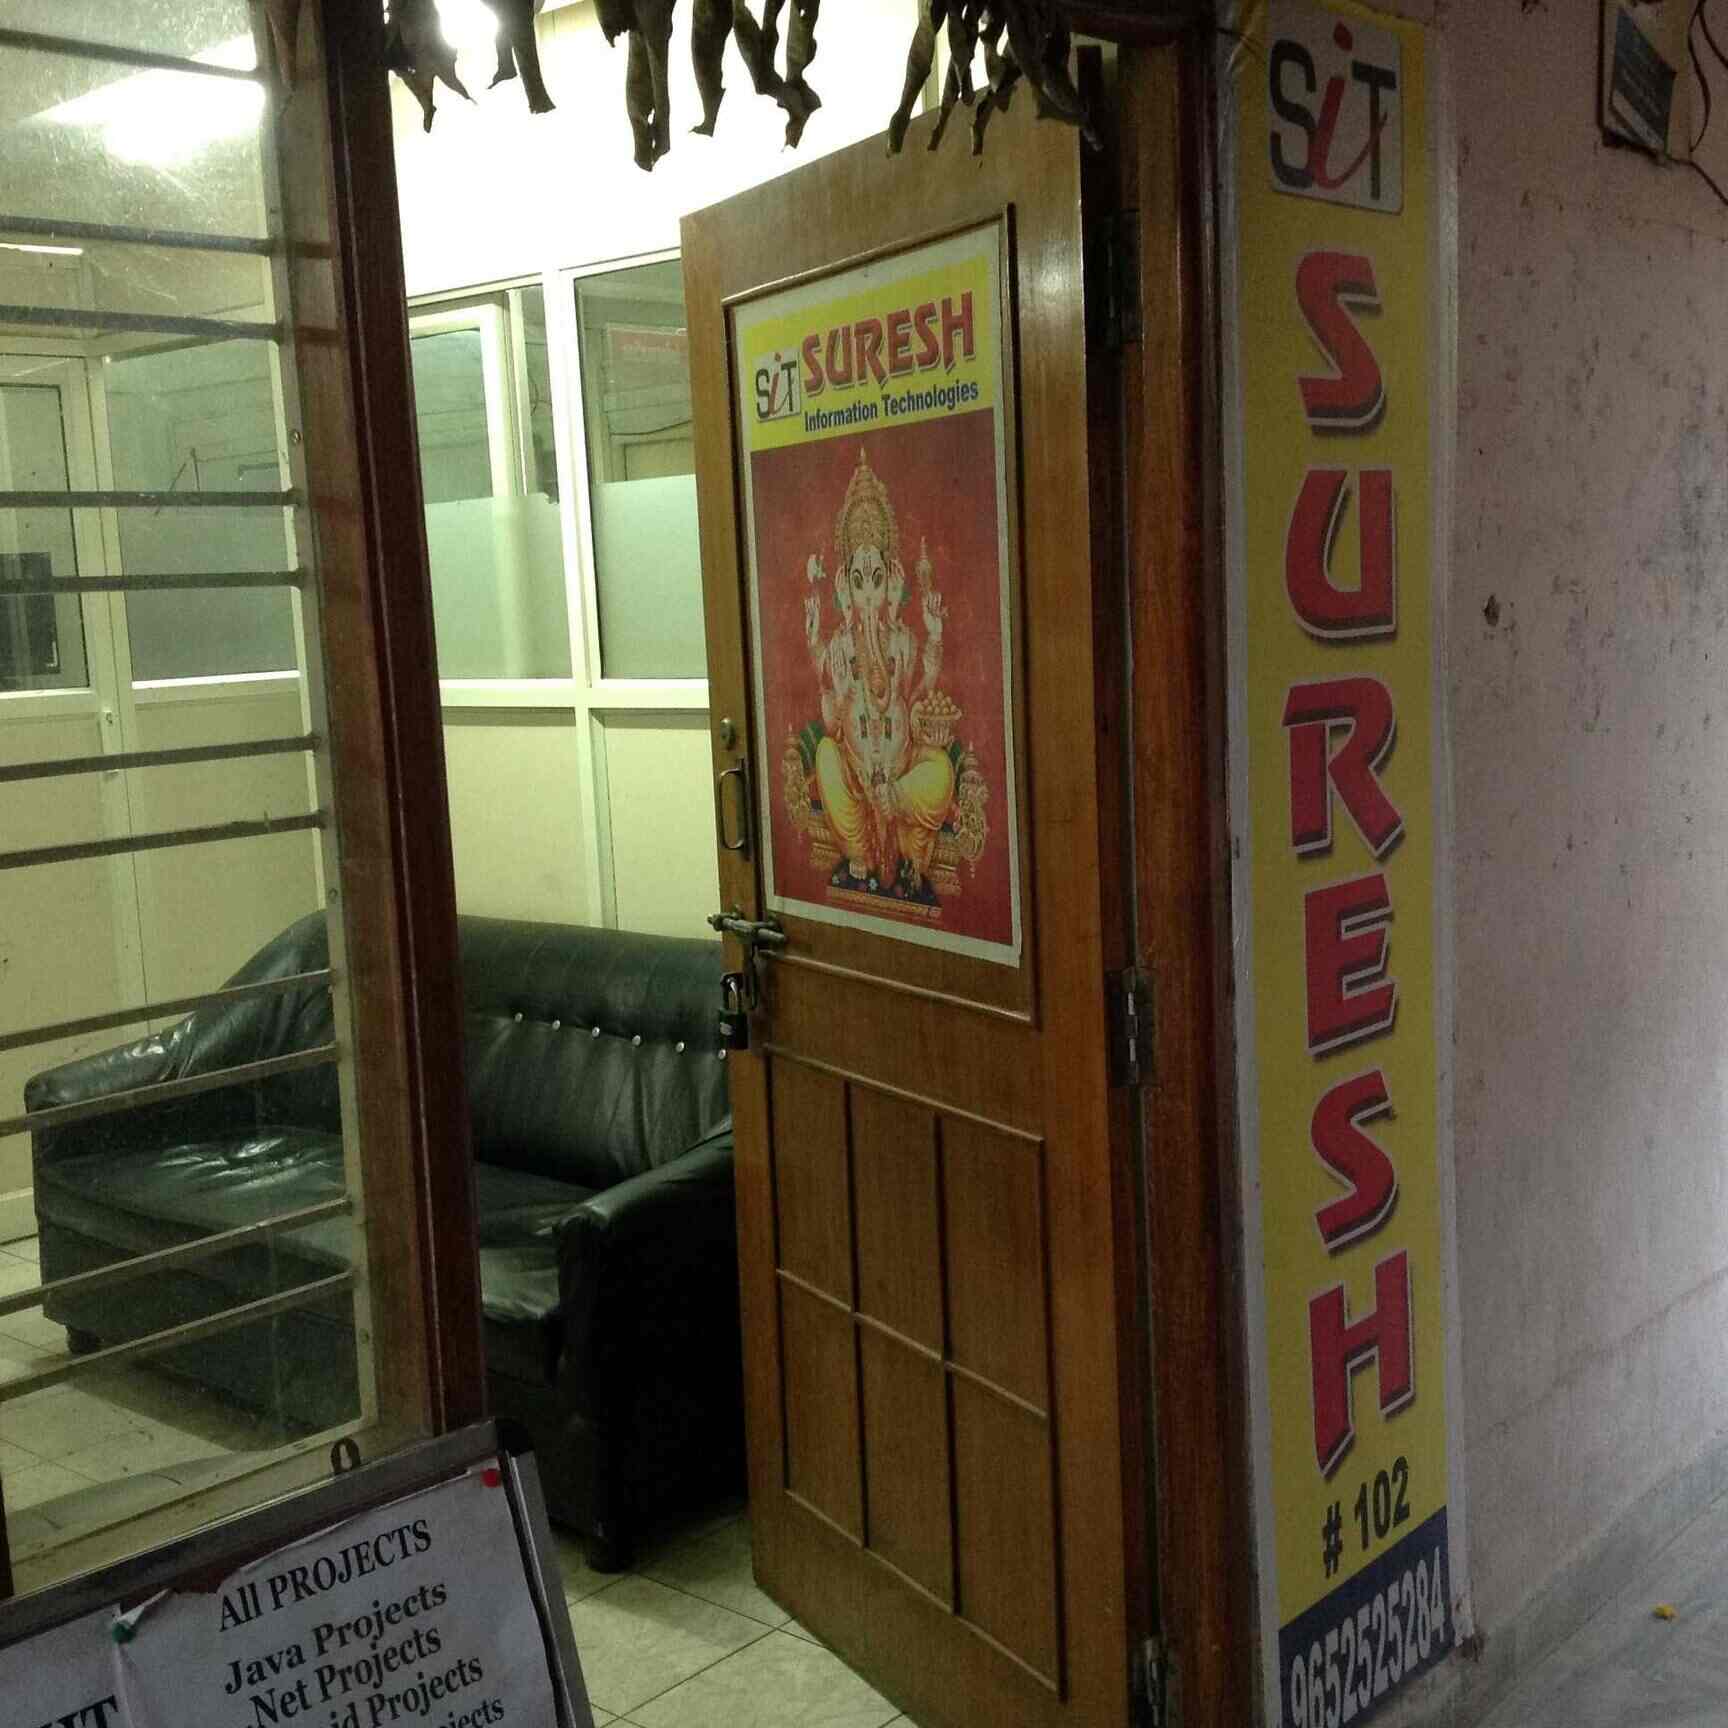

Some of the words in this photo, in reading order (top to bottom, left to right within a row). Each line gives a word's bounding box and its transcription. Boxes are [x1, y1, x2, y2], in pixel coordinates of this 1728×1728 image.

[801, 291, 976, 398] SURESH
[804, 401, 879, 433] Information
[882, 378, 979, 418] Technologies
[1284, 249, 1414, 1482] SURESH
[1322, 1501, 1344, 1579] #
[1354, 1456, 1410, 1551] 102
[219, 1584, 263, 1632] All
[267, 1519, 433, 1611] PROJECTS
[224, 1643, 306, 1695] Java
[311, 1582, 448, 1657] Projects
[313, 1625, 442, 1702] Projects
[365, 1656, 483, 1728] Projects
[1290, 1545, 1445, 1728] 9652525284
